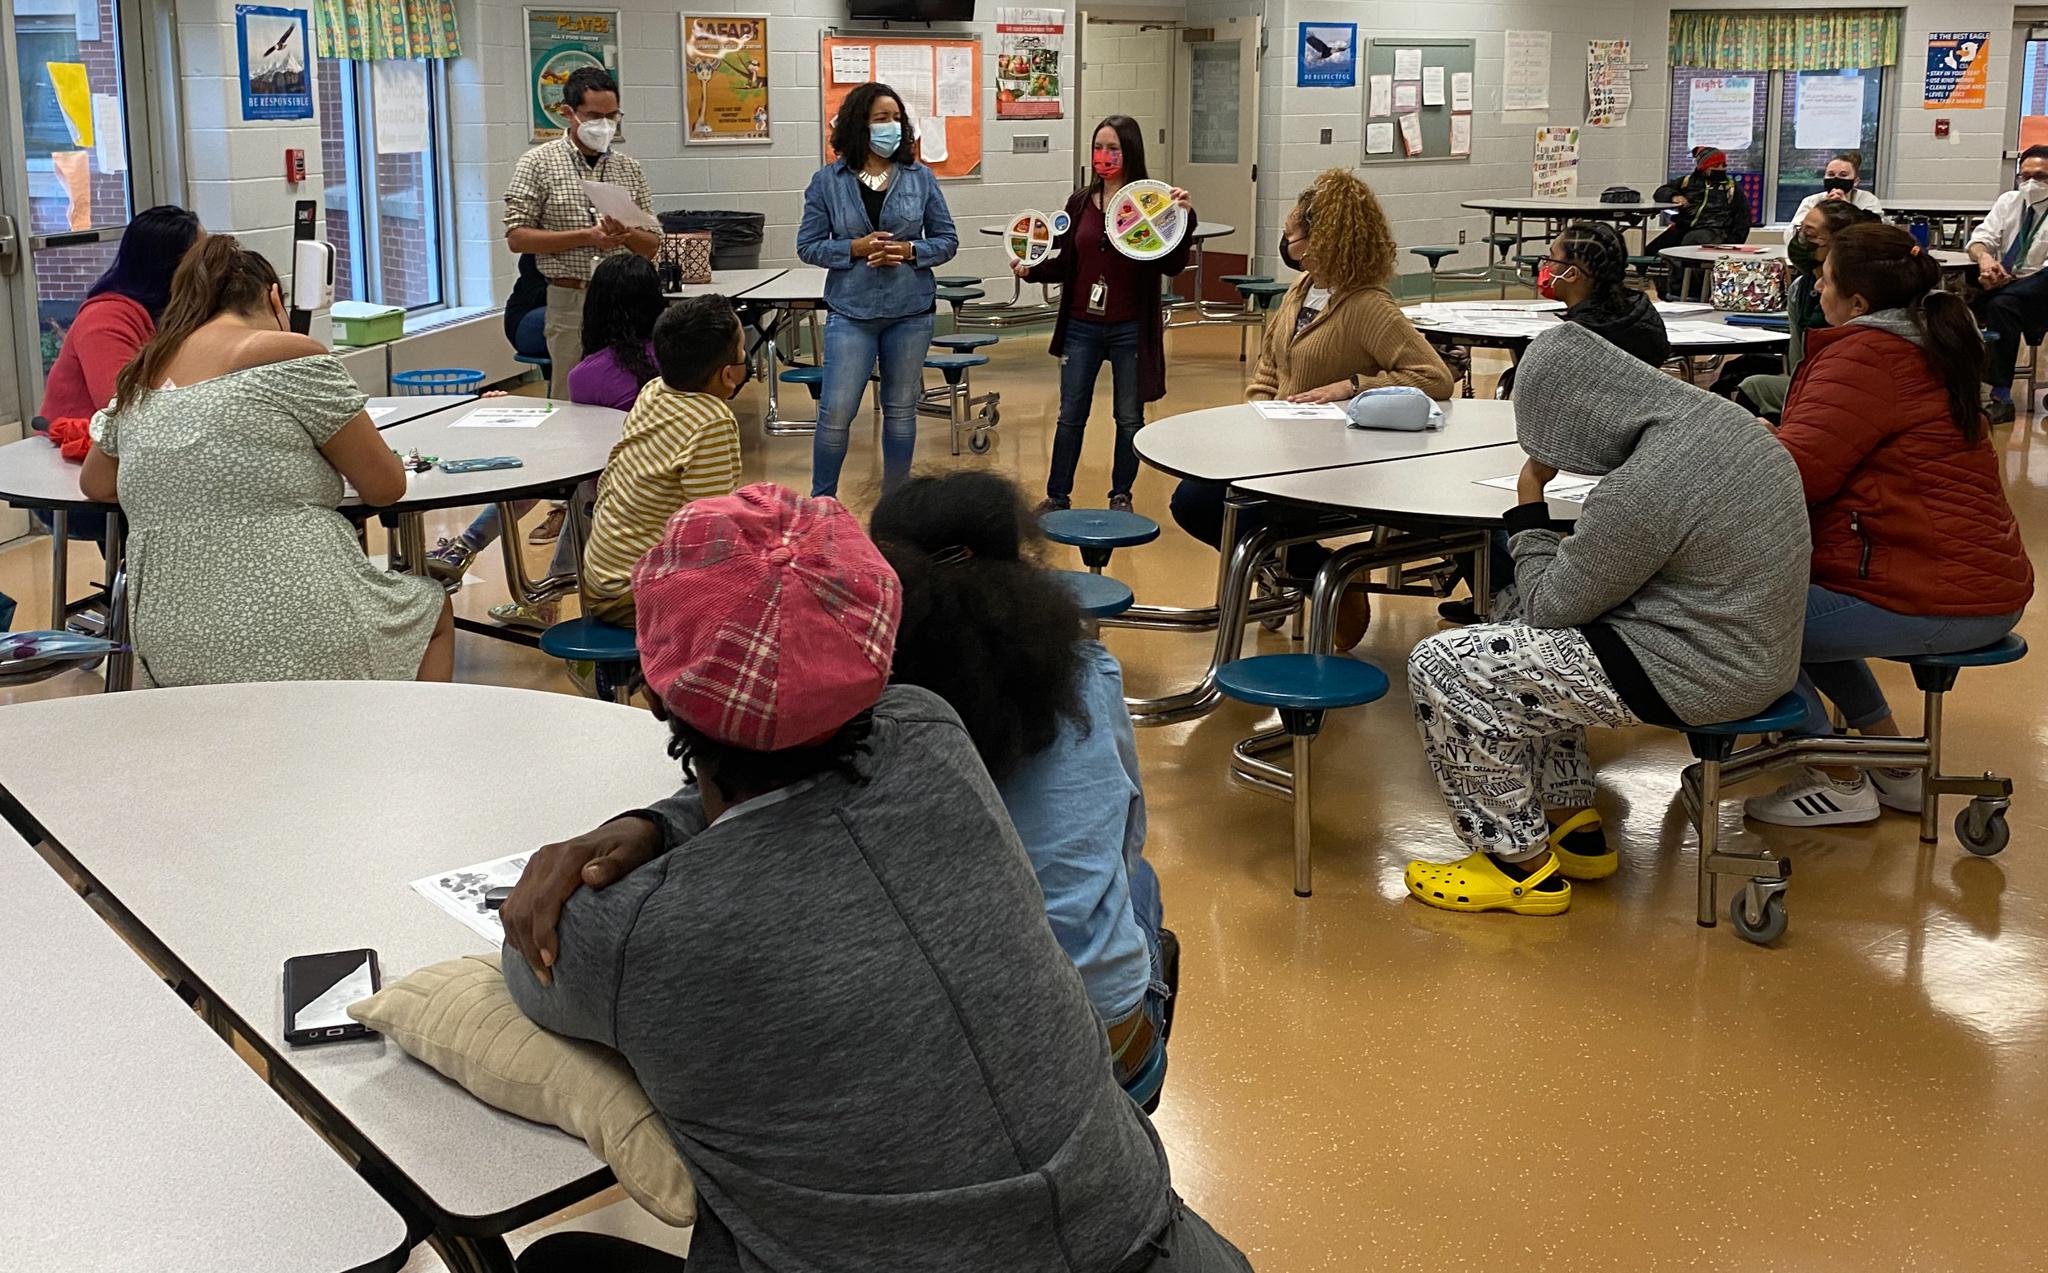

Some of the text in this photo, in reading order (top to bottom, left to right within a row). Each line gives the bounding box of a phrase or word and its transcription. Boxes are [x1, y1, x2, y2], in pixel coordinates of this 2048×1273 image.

[248, 96, 309, 107] BE RESPONSIBLE
[1432, 638, 1458, 661] FINEST
[1445, 743, 1475, 763] NY
[1554, 759, 1581, 779] NY
